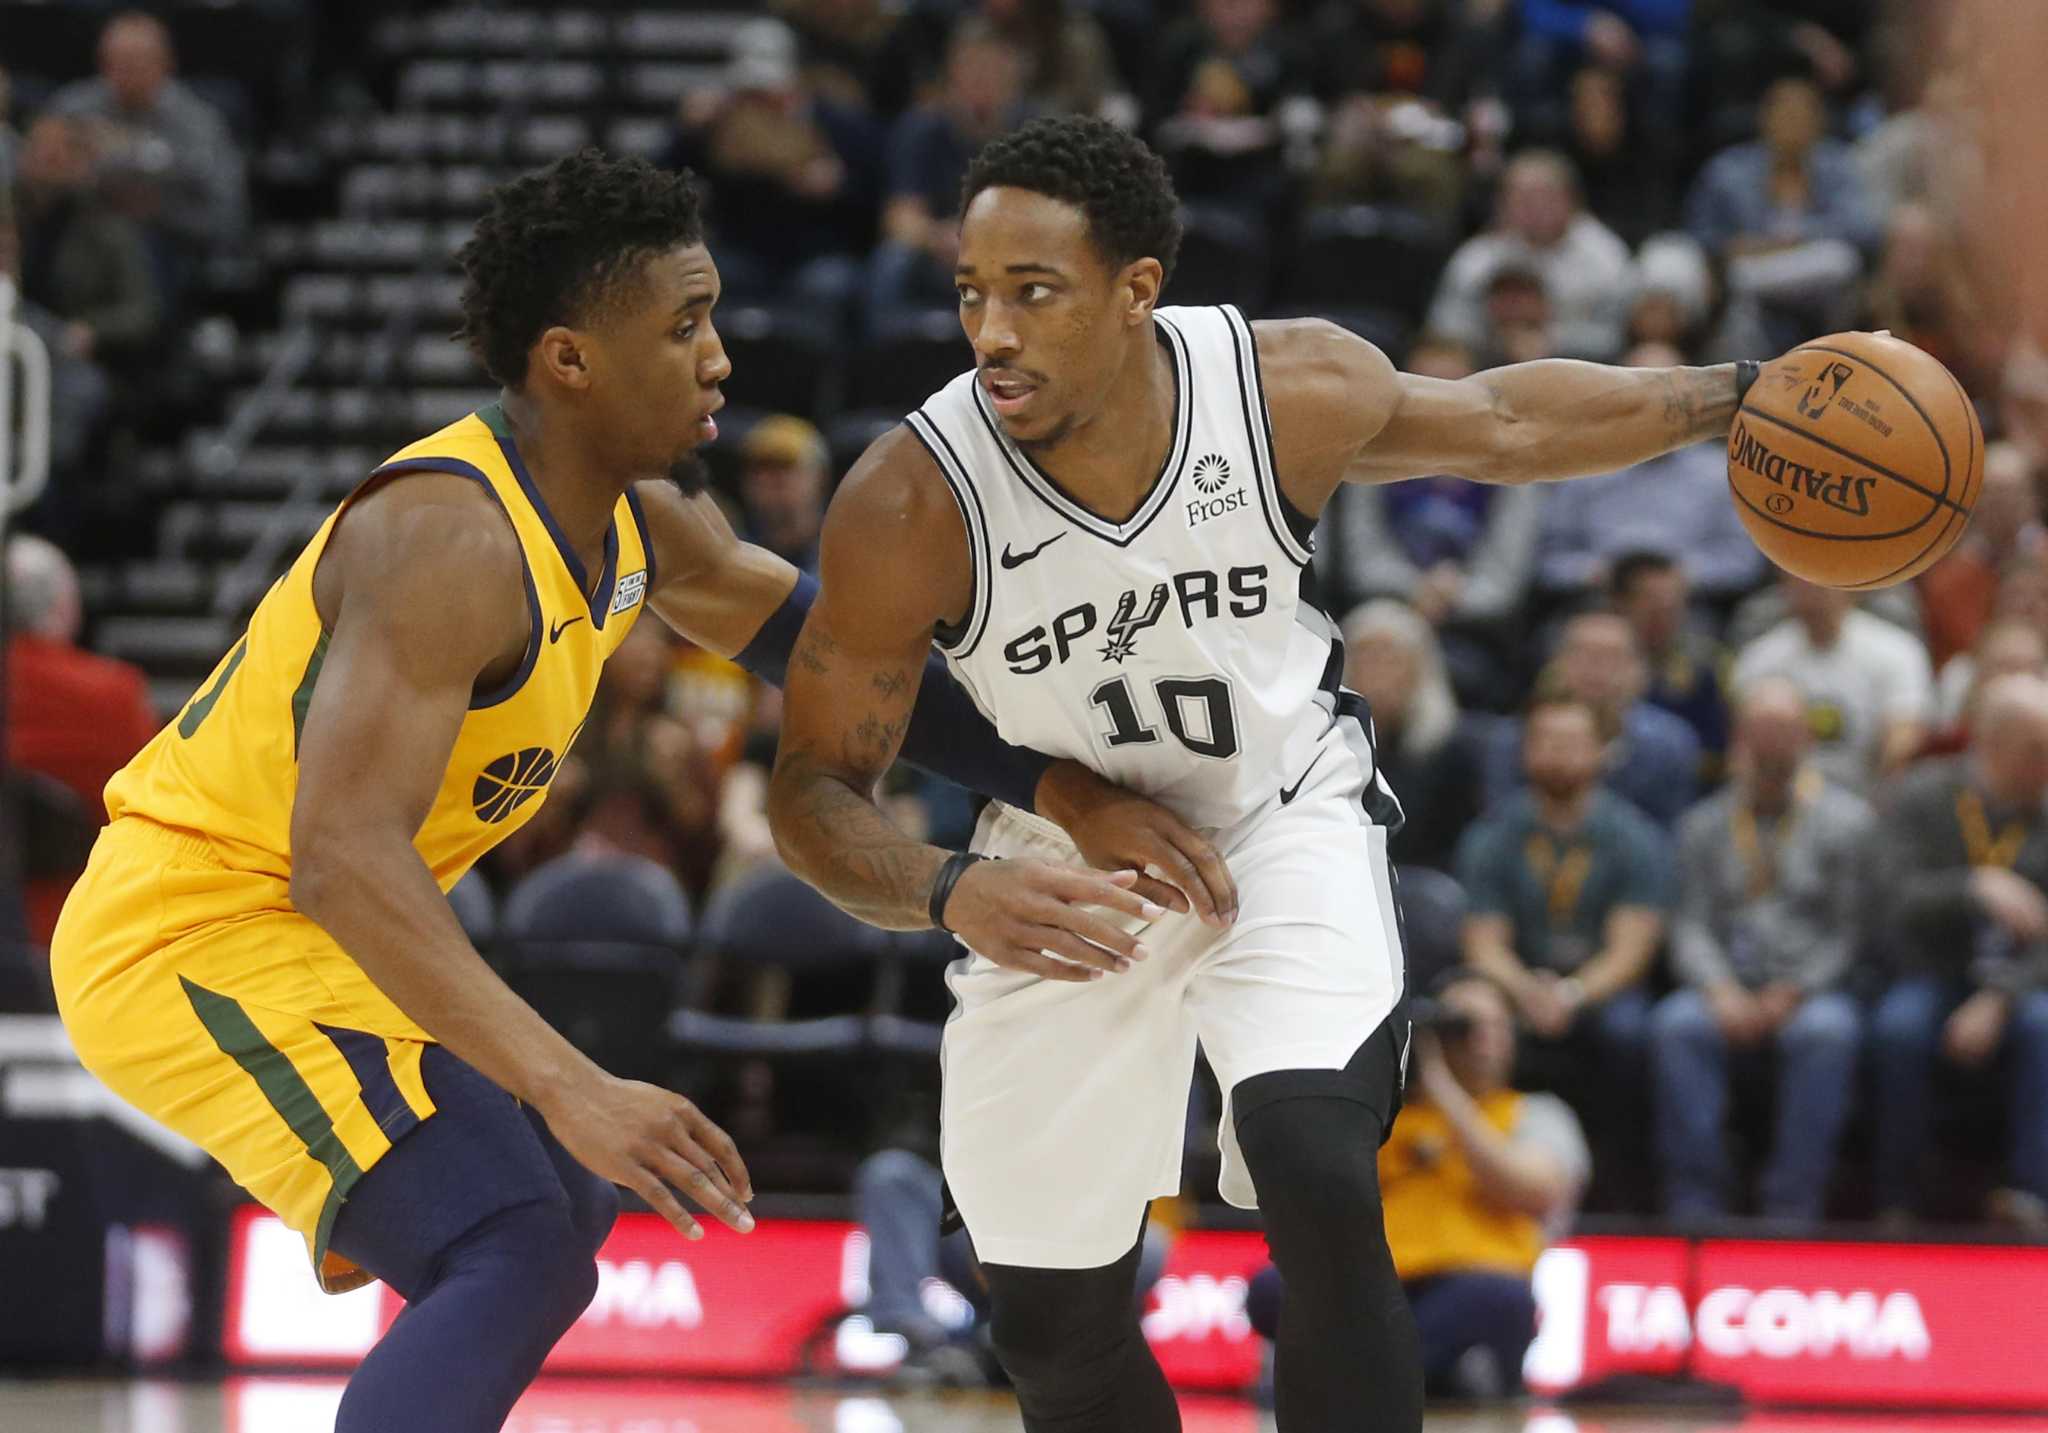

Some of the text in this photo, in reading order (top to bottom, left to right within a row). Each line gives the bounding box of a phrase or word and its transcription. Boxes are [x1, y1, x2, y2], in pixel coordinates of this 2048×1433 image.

[1186, 487, 1249, 528] Frost
[1731, 420, 1876, 516] SPALDING
[1004, 565, 1268, 675] SPURS
[1088, 673, 1242, 762] 10
